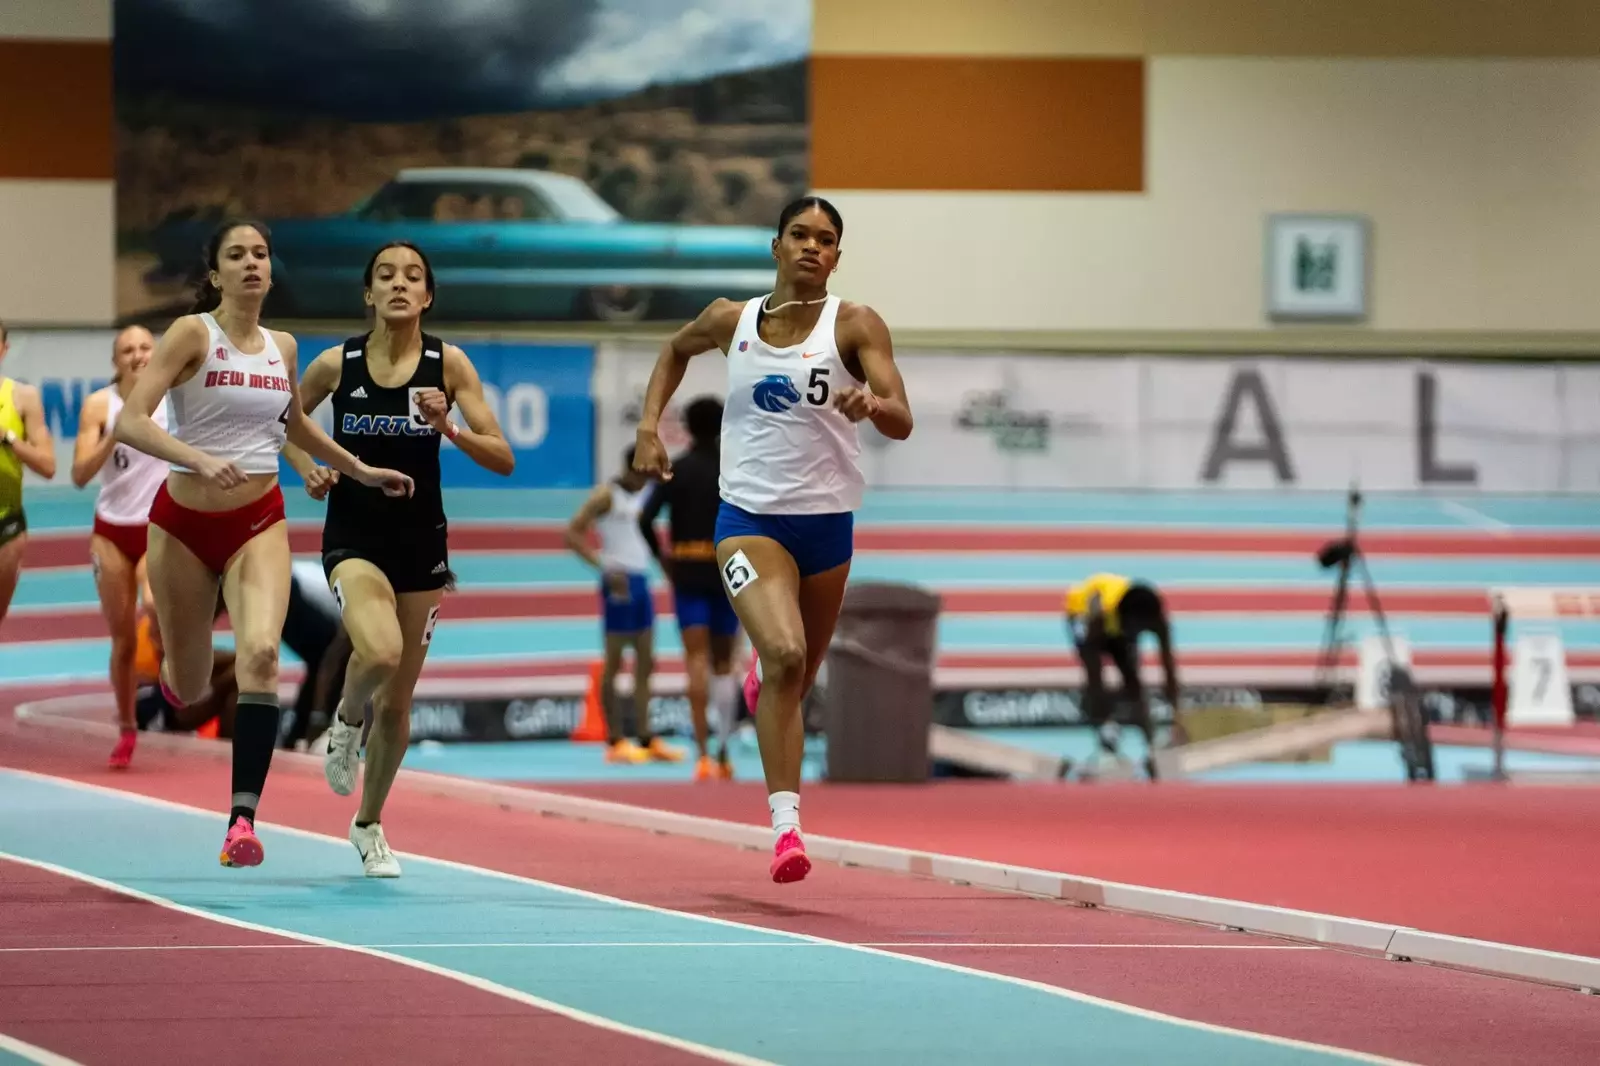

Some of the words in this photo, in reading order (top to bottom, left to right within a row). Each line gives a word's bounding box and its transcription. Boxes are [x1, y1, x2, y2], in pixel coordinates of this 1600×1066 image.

[204, 370, 244, 387] NEW
[249, 374, 291, 392] MEXIC
[806, 367, 830, 406] 5
[342, 413, 436, 436] BART
[1202, 369, 1295, 483] A
[1416, 371, 1478, 483] L
[113, 446, 129, 469] 6
[724, 557, 750, 590] 5
[1531, 657, 1553, 706] 7
